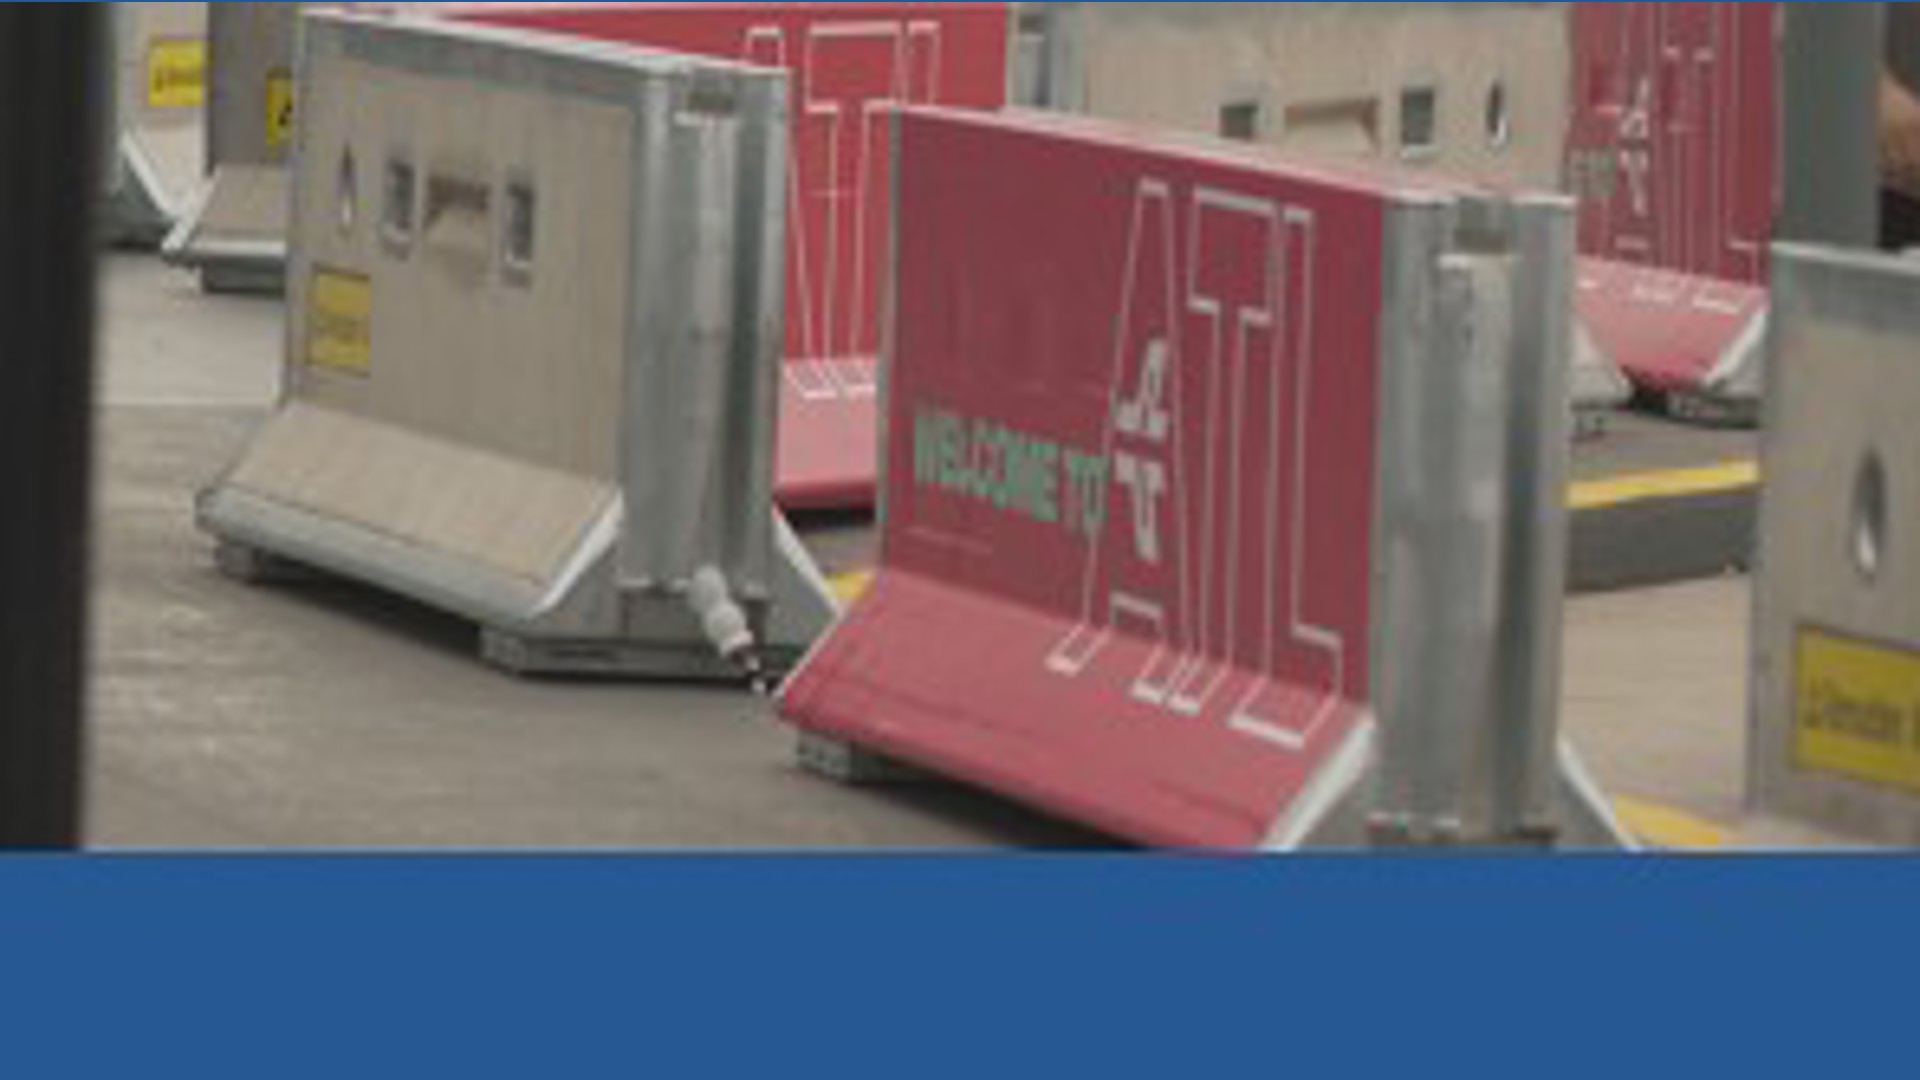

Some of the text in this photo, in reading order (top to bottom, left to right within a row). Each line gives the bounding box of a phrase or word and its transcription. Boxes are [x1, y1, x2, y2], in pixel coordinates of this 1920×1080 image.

[914, 177, 1342, 747] WELCOME TO ATL
